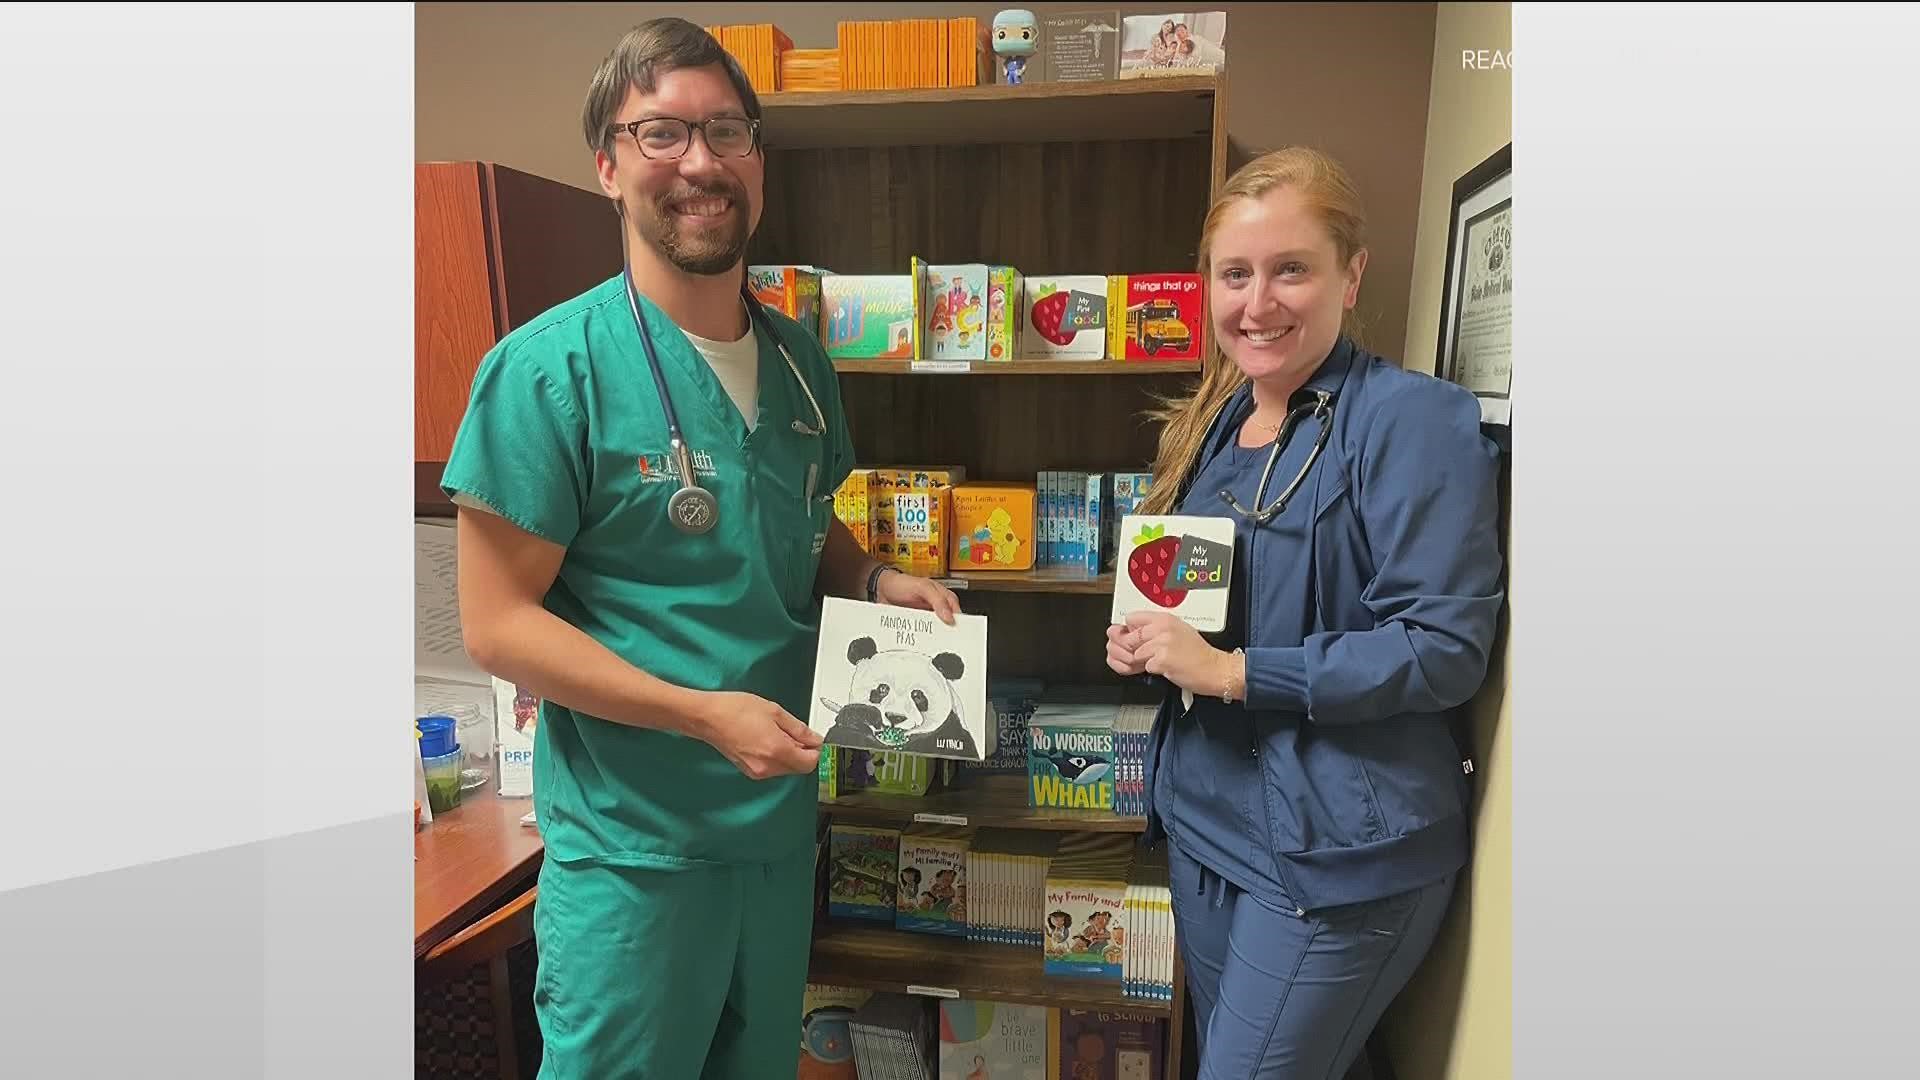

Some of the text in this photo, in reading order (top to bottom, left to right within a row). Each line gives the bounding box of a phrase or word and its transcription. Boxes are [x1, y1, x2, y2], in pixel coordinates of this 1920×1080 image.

[1134, 280, 1198, 292] things that go
[1078, 297, 1090, 307] My
[897, 496, 925, 508] first
[897, 508, 926, 523] 100
[1192, 545, 1208, 557] My
[1190, 557, 1208, 566] First
[1177, 563, 1221, 583] Food
[880, 615, 933, 634] PANDAS LOVE
[896, 631, 916, 646] PEAS
[1000, 729, 1028, 746] SAY
[1033, 733, 1112, 752] NO WORRIES
[505, 751, 532, 762] PRP
[1033, 775, 1112, 809] WHALE
[1047, 891, 1120, 909] My Family and
[1000, 1023, 1038, 1037] brave
[1021, 1054, 1041, 1065] one
